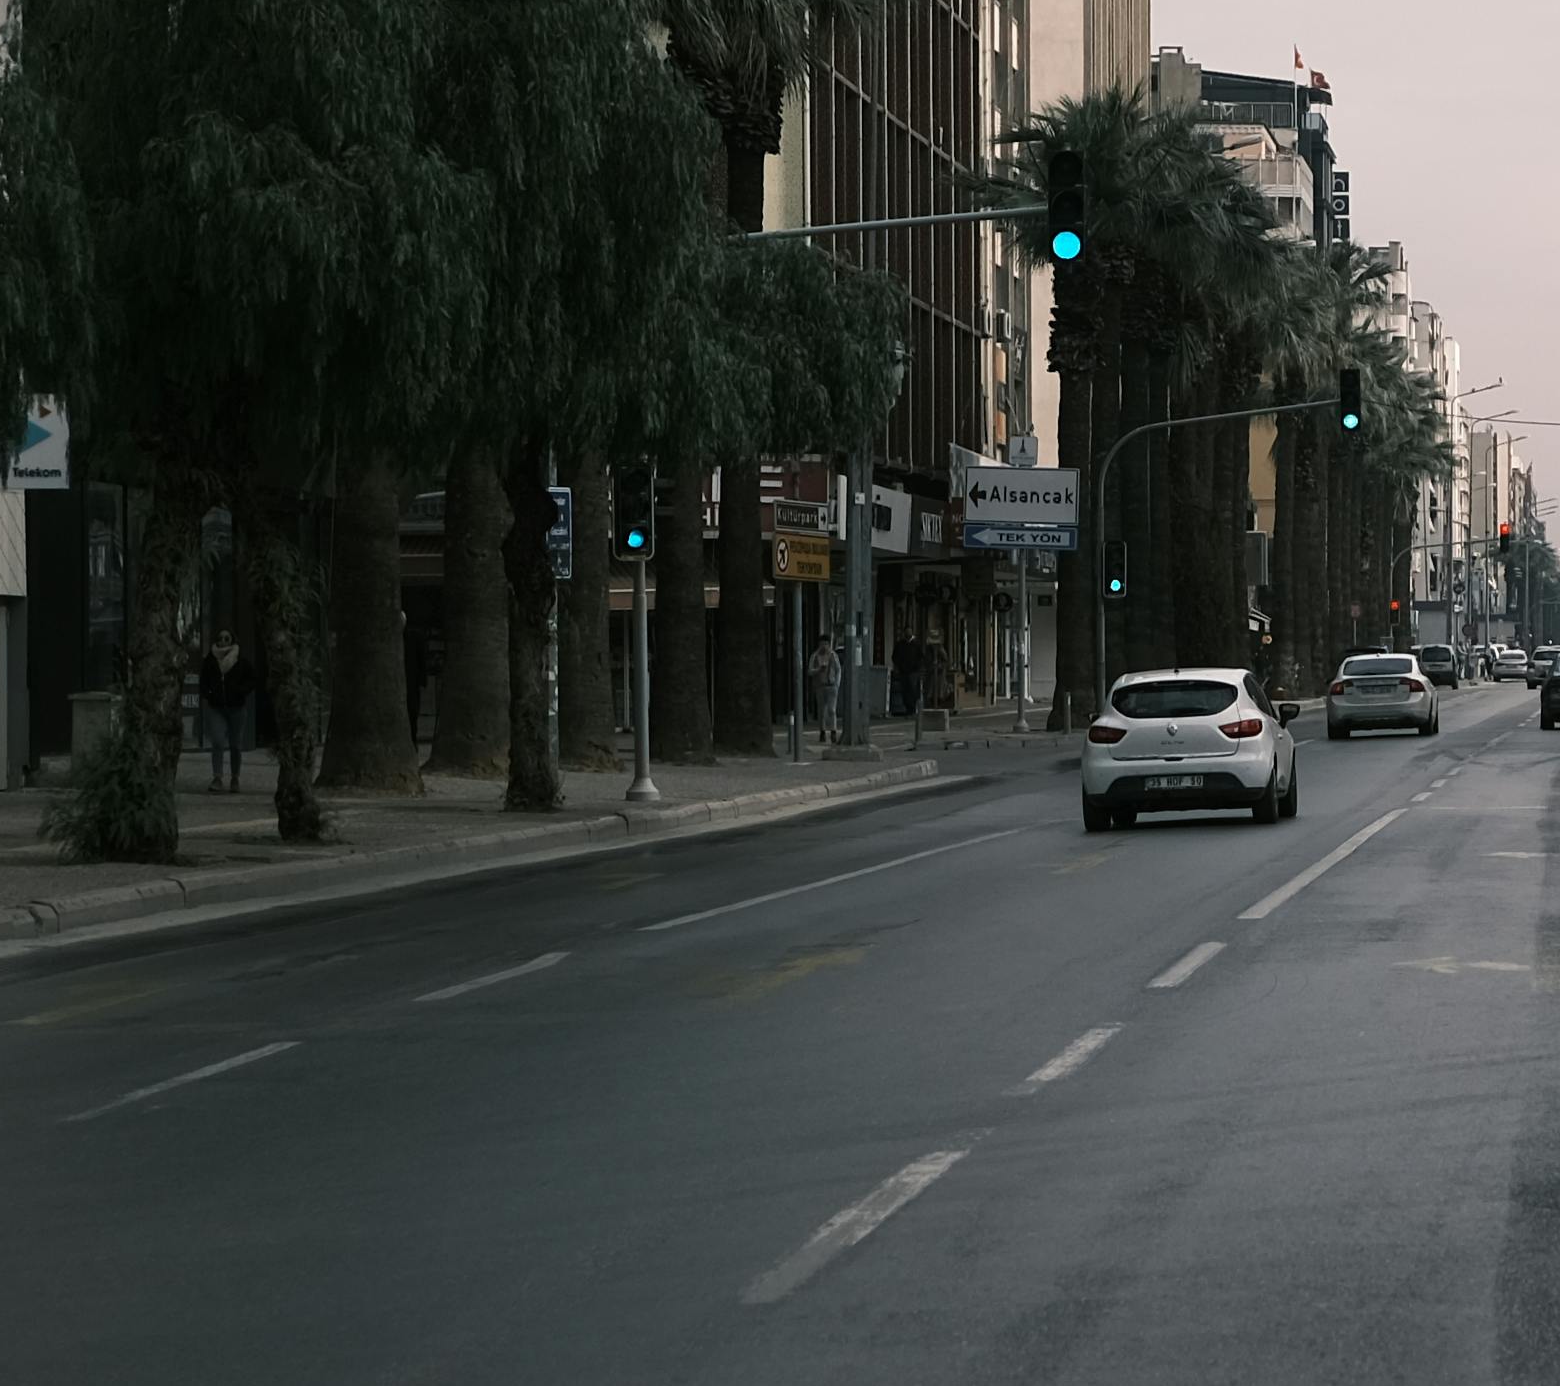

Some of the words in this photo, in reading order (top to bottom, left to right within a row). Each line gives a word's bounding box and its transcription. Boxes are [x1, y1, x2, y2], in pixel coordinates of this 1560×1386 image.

[13, 467, 62, 478] Telekom
[990, 486, 1074, 505] Alsancak
[997, 532, 1026, 543] TEK
[1032, 532, 1062, 544] YÖN
